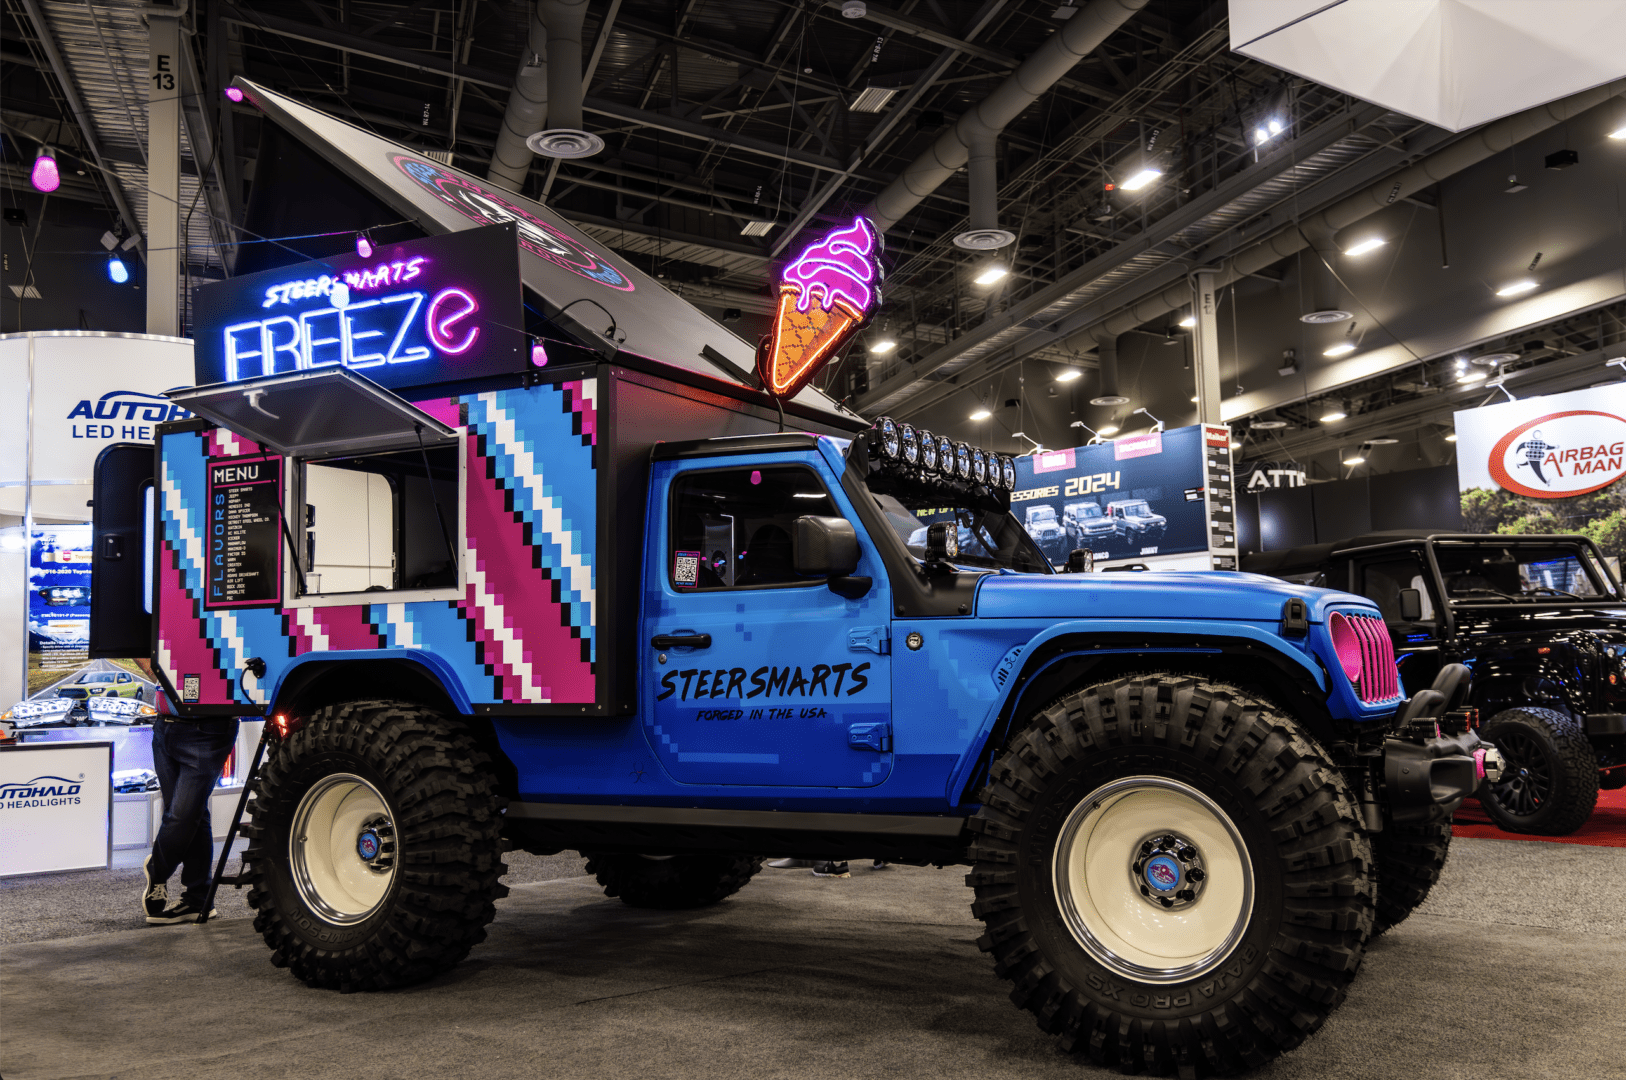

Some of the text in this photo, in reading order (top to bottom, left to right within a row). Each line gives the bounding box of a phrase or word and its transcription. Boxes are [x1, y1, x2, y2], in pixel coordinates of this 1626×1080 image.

[157, 54, 171, 72] E
[152, 73, 175, 91] 13
[66, 400, 193, 421] AUTOH
[72, 424, 155, 440] LED HE
[1543, 441, 1625, 477] AIRBAG
[1573, 456, 1623, 476] MAN
[214, 465, 259, 483] MENU
[1064, 470, 1121, 497] 2024
[213, 493, 225, 597] FLAVORS
[656, 661, 871, 702] STEERSMARTS
[696, 707, 828, 721] FORGED IN THE USA
[7, 796, 81, 809] HEADLIGHTS
[1085, 972, 1125, 1001] XS
[1129, 990, 1192, 1010] PRO
